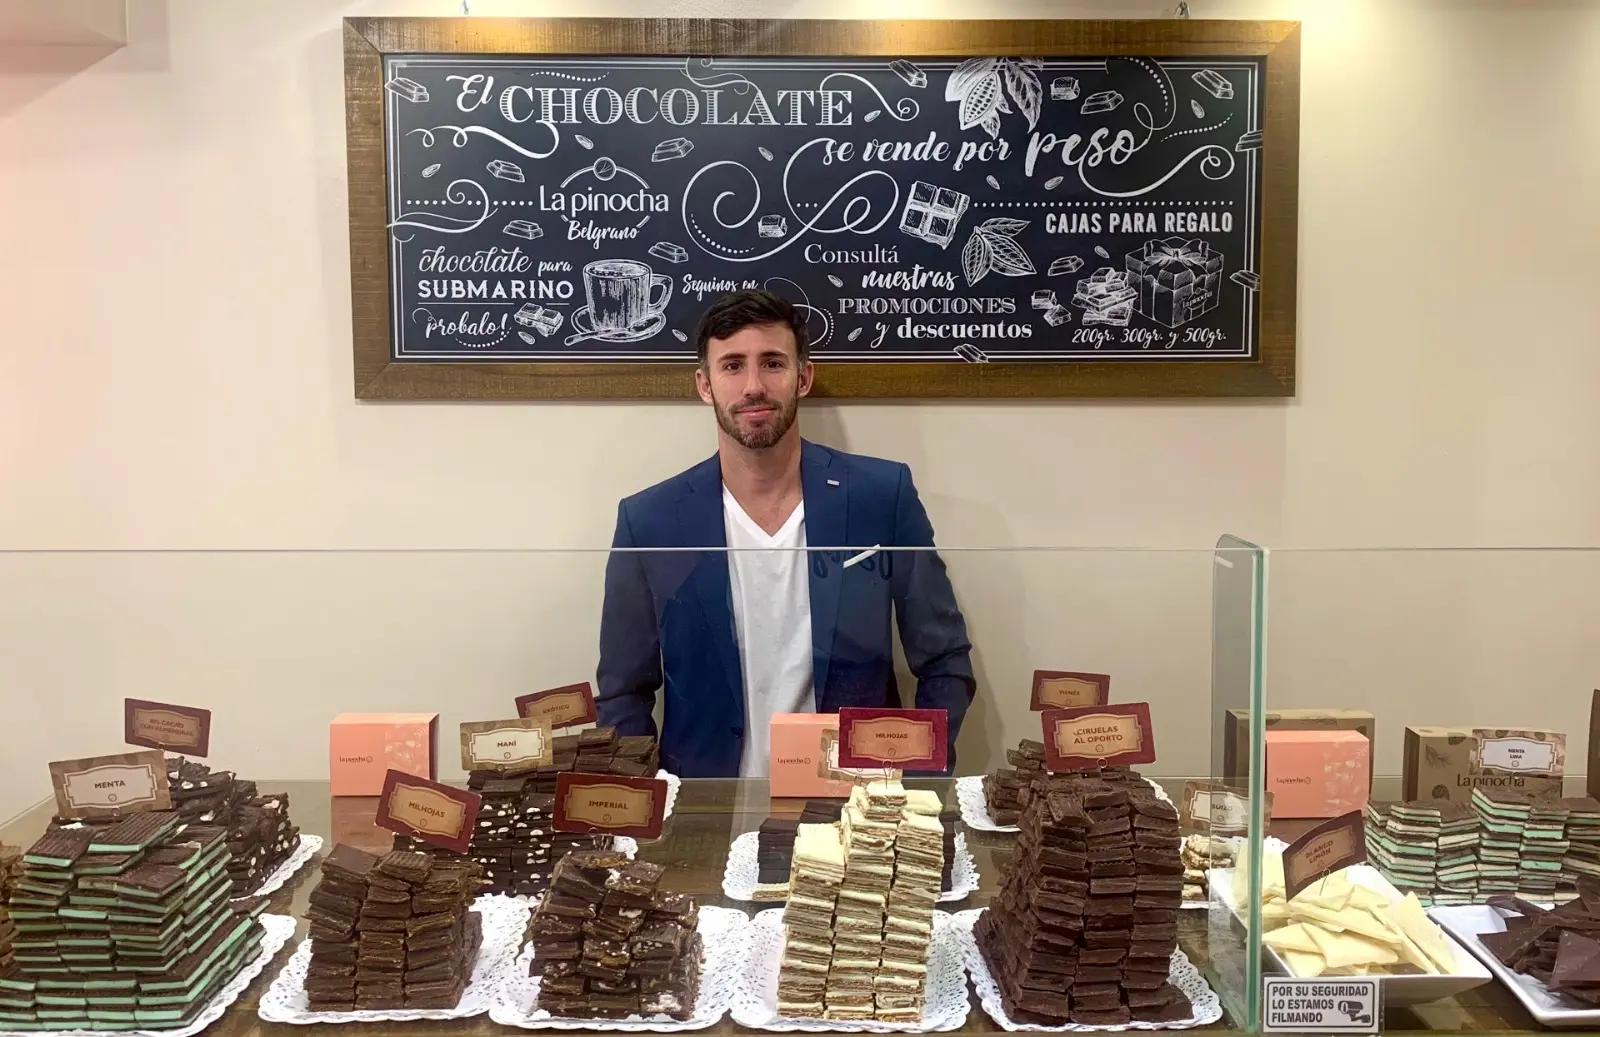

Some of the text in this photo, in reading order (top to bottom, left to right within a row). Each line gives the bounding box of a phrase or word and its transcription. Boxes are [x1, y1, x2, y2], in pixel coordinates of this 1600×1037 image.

[446, 74, 852, 125] El CHOCOLATE
[823, 127, 1141, 177] se vende por peso
[540, 185, 669, 217] La pinocha
[1045, 211, 1233, 234] CAJAS PARA REGALO
[567, 219, 639, 249] Belgrano
[418, 246, 573, 277] chocolate para
[804, 243, 900, 264] Consultá
[742, 278, 759, 290] en
[861, 263, 959, 291] nuestras
[418, 279, 574, 299] SUBMARINO
[837, 297, 1017, 315] PROMOCIONES
[425, 310, 509, 339] probalo!
[870, 317, 1033, 349] y descuentos
[1072, 327, 1227, 349] 200gr. 300gr. y 500gr.
[1074, 734, 1124, 745] AL OPORTO
[1076, 725, 1118, 736] CIRUELAS
[496, 739, 517, 748] MANÍ
[94, 780, 126, 789] MENTA
[1457, 773, 1471, 787] La
[408, 801, 446, 818] MILHOJAS
[588, 800, 629, 810] IMPERIAL
[1272, 985, 1369, 996] POR SU SEGURIDAD
[1272, 999, 1334, 1010] LO ESTAMOS
[1271, 1012, 1323, 1023] FILMANDO
